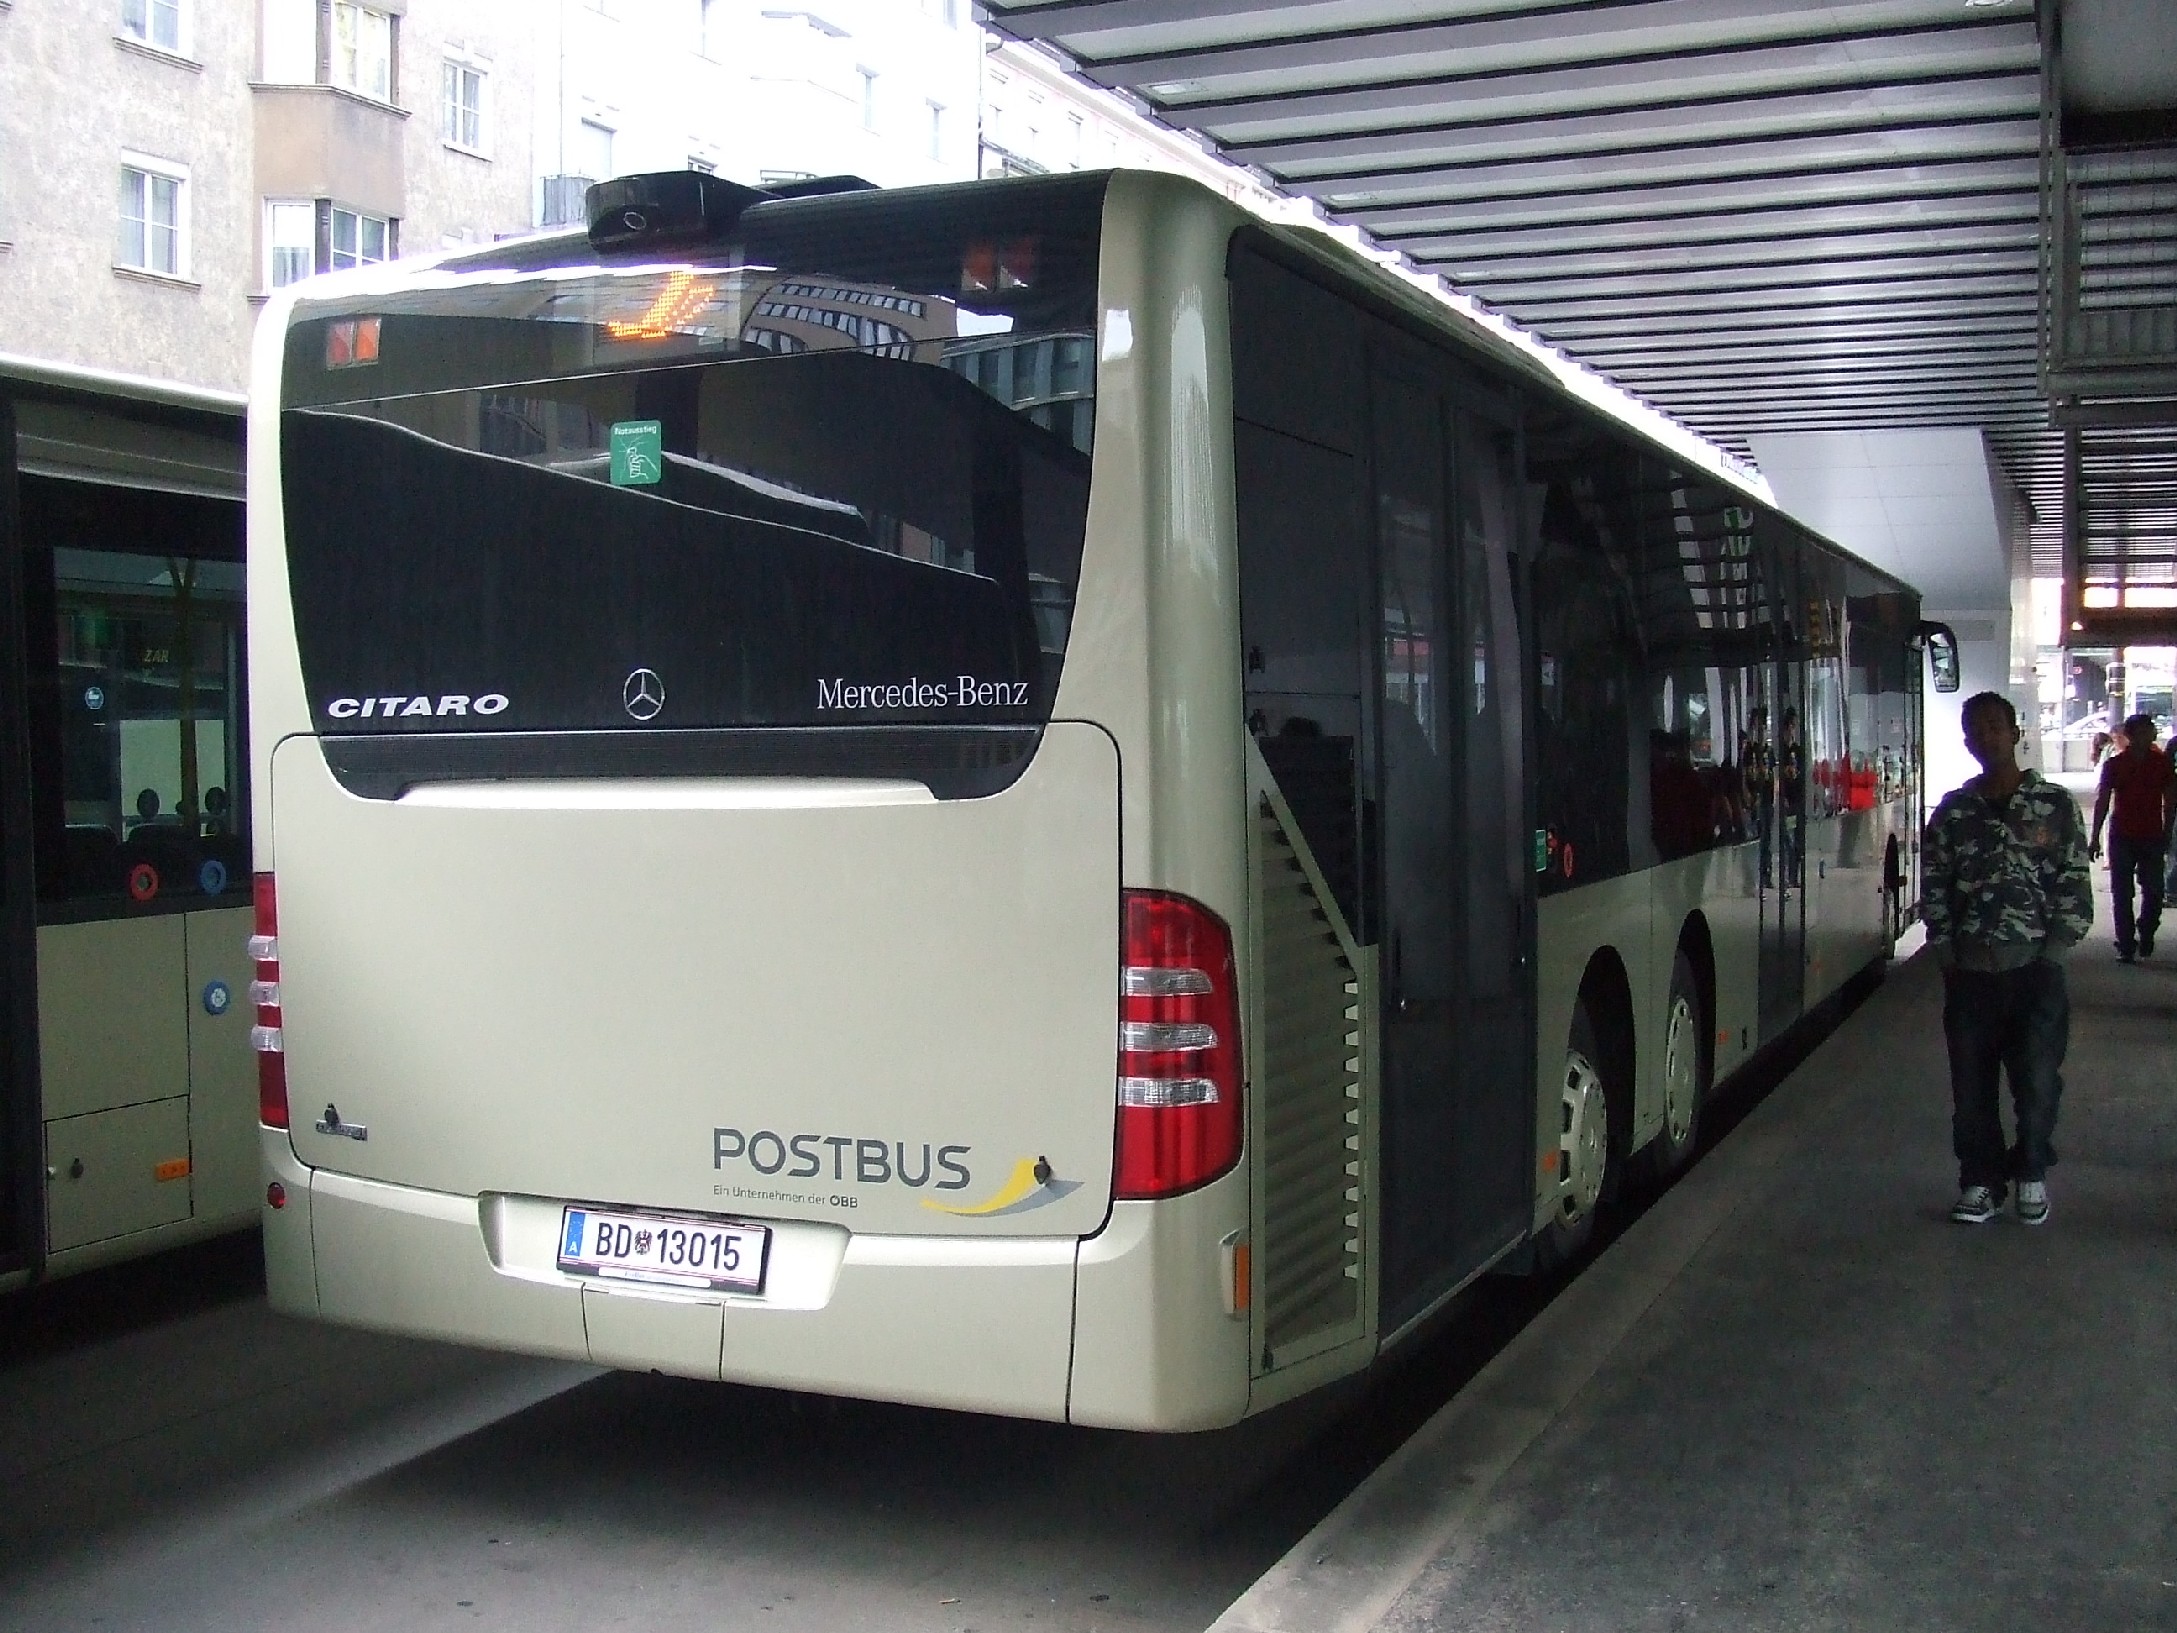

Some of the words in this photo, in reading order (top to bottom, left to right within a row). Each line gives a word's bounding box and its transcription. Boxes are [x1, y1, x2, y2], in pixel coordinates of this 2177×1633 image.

[327, 693, 509, 718] CITARO
[817, 675, 1029, 710] Mercedes-Benz
[713, 1127, 972, 1190] POSTBUS
[713, 1185, 729, 1196] Ein
[732, 1187, 805, 1203] Unternehmen
[807, 1193, 825, 1205] der
[568, 1241, 579, 1253] A
[595, 1222, 632, 1258] BD
[657, 1228, 742, 1271] 13015
